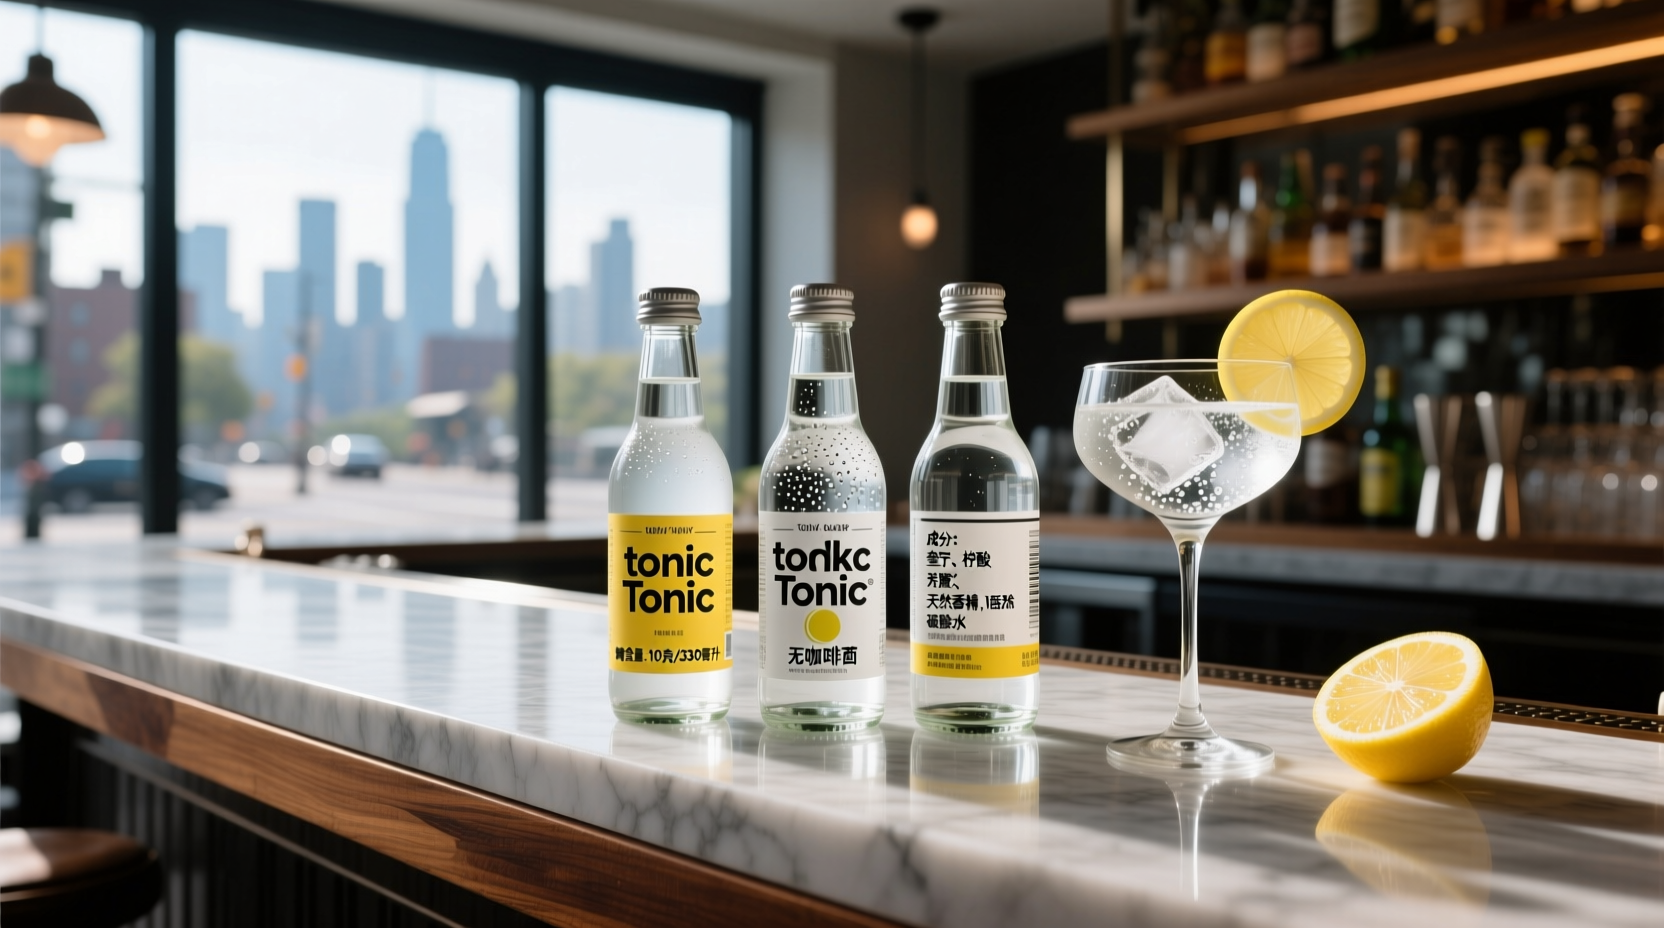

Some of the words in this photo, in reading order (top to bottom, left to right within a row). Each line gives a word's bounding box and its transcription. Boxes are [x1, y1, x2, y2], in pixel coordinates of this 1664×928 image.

[624, 544, 714, 578] tonic
[622, 580, 715, 614] Tonic
[774, 574, 868, 607] Tonic
